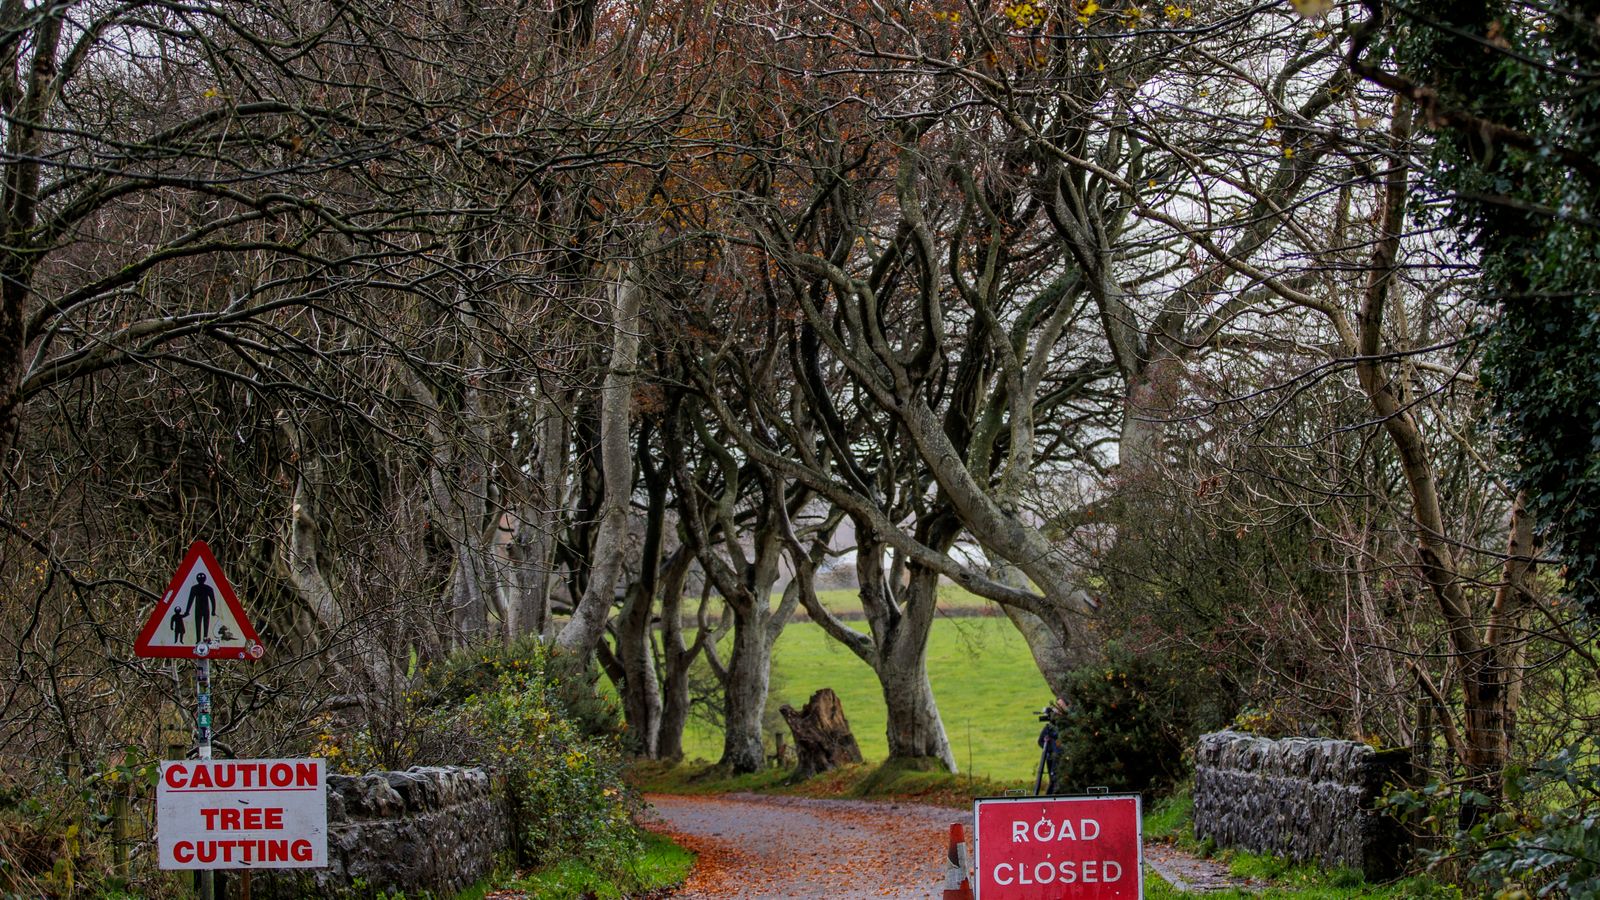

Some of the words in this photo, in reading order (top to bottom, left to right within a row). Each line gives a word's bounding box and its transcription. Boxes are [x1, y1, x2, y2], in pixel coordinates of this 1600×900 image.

[165, 763, 318, 788] CAUTION
[200, 808, 284, 830] TREE
[1012, 818, 1101, 843] ROAD
[173, 838, 313, 863] CUTTING
[993, 860, 1123, 885] CLOSED
